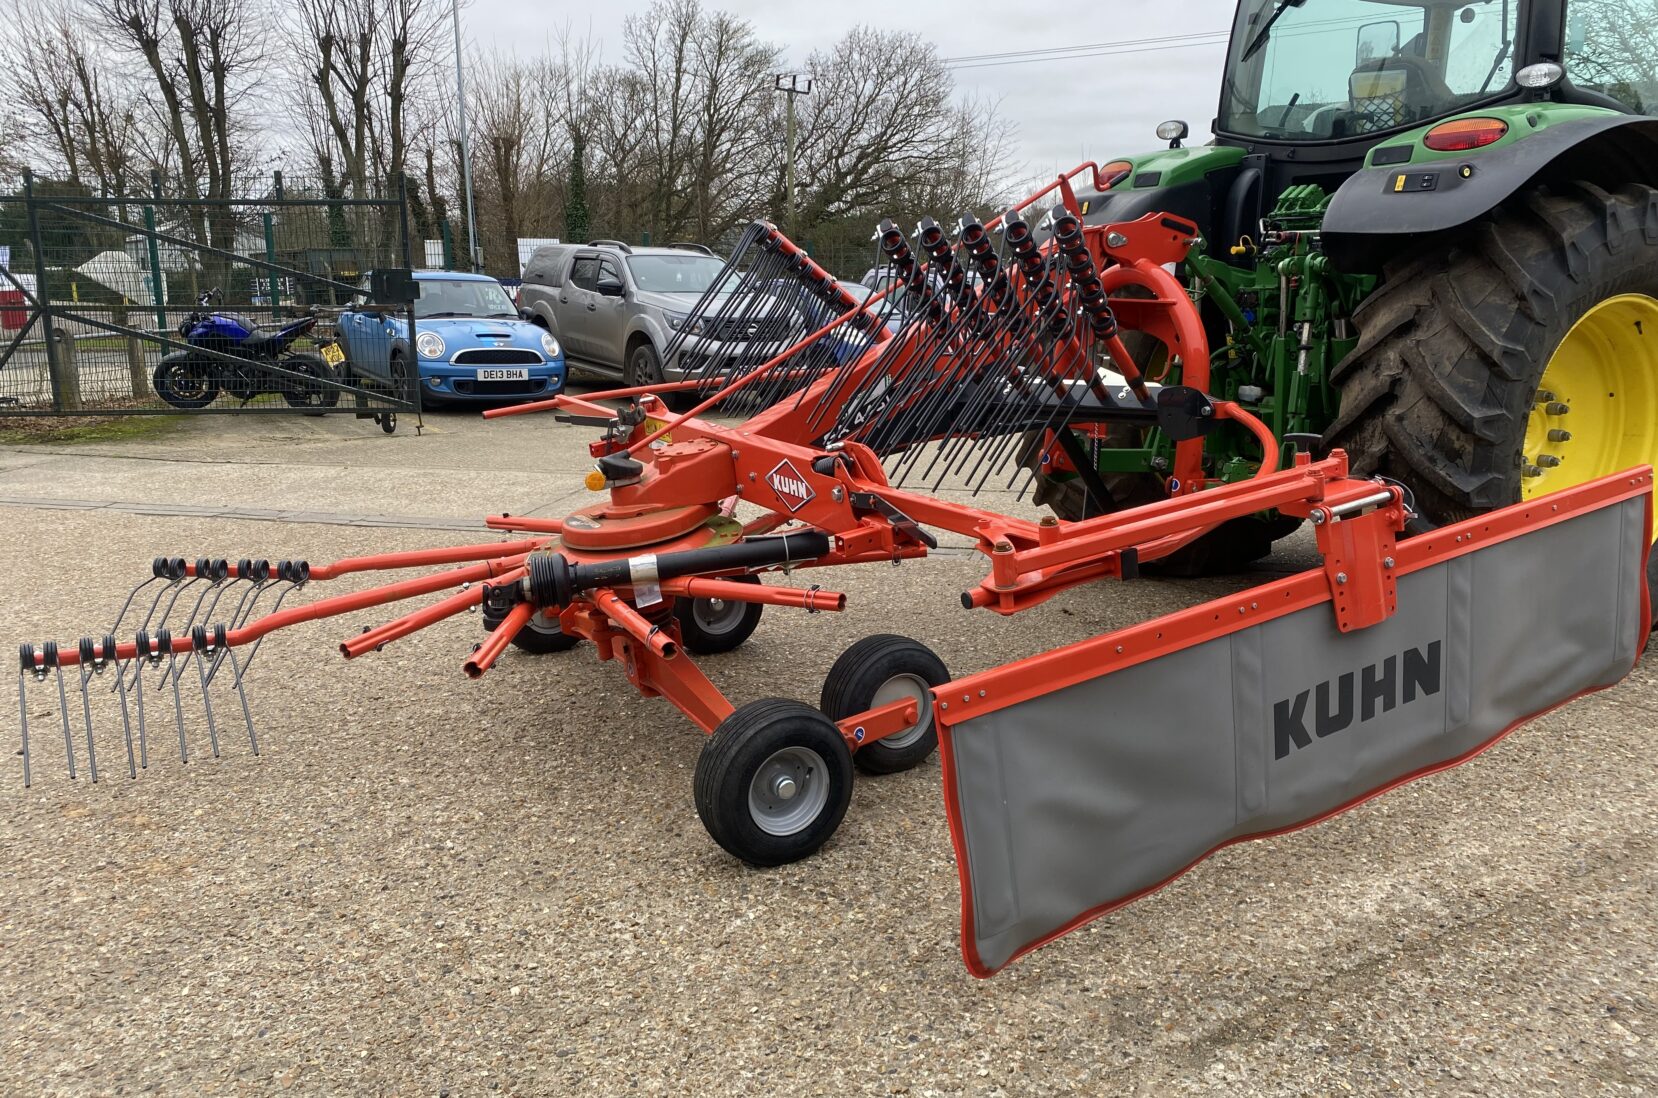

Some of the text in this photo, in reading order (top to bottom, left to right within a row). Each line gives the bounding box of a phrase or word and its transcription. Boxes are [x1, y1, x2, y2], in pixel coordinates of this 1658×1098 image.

[484, 370, 523, 379] DE13 BHA
[772, 473, 807, 499] KUHN
[1273, 639, 1442, 761] KUHN
